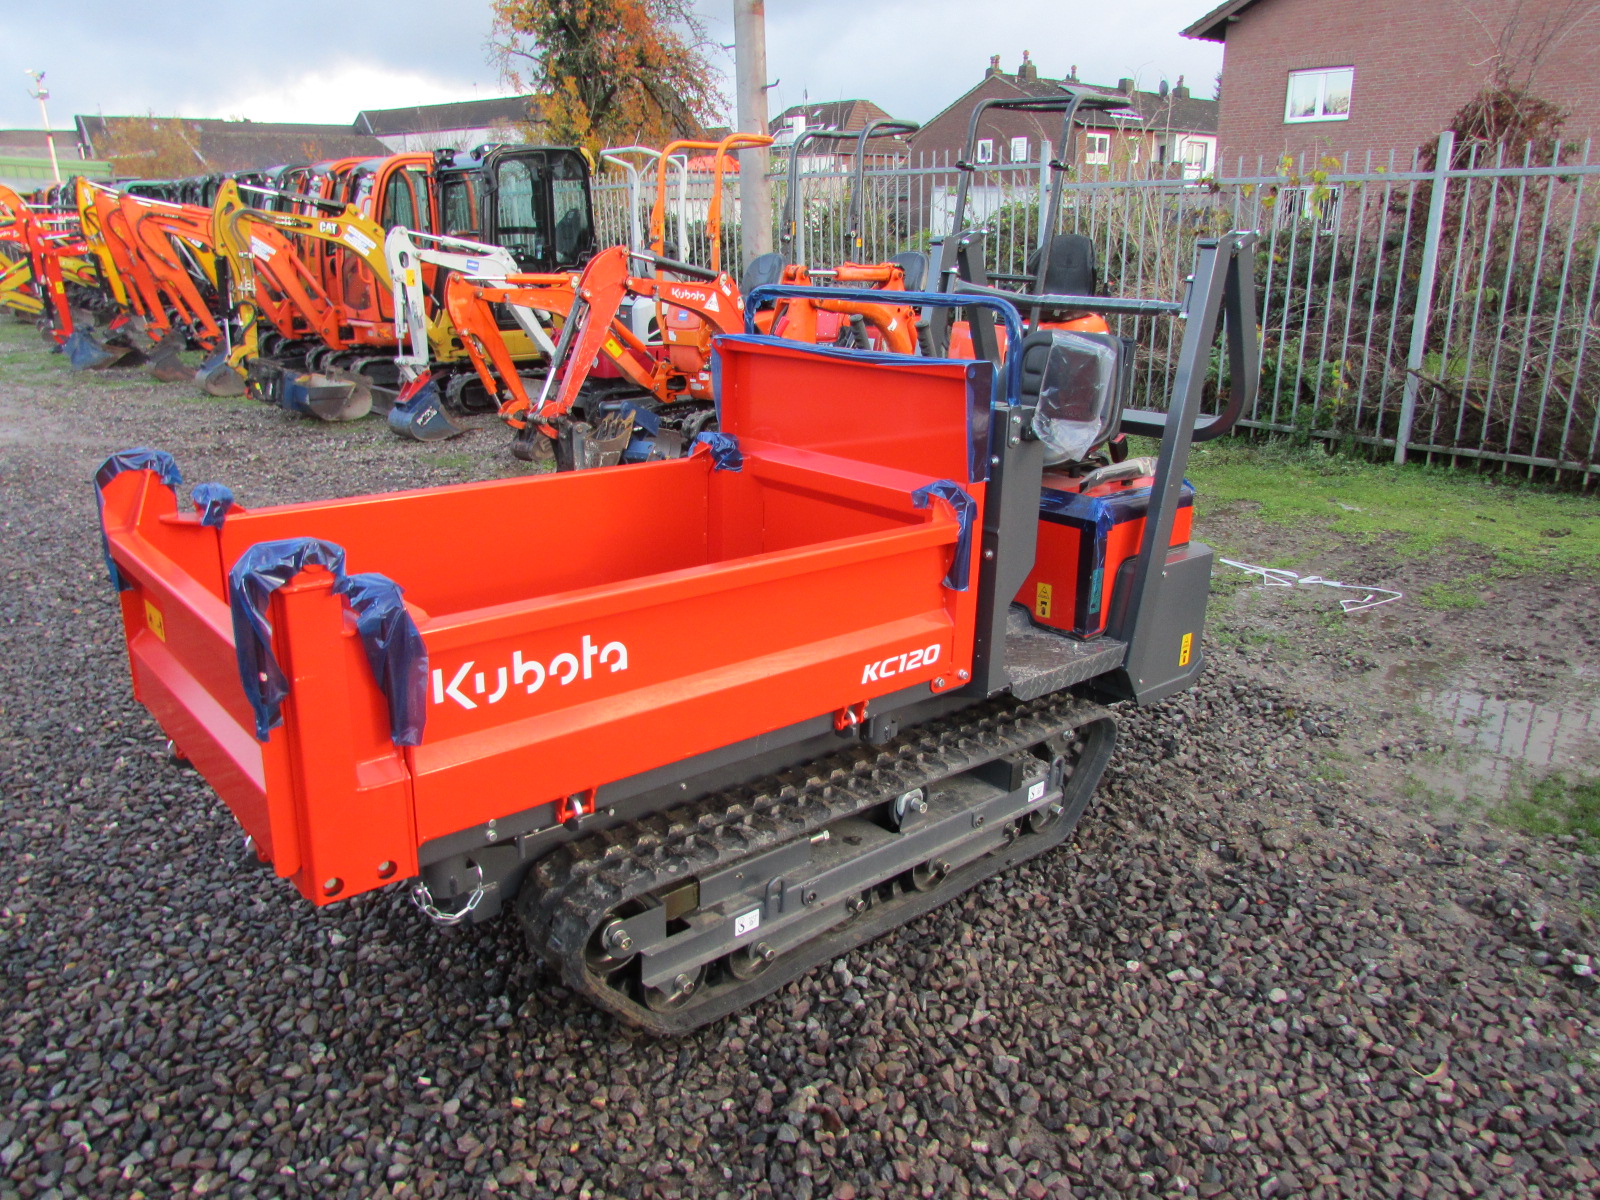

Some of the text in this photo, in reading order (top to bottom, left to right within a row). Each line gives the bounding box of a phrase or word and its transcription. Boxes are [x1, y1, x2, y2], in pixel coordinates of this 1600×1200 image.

[319, 221, 338, 235] CAT
[671, 287, 706, 302] Kubota
[432, 634, 628, 710] Kubota
[861, 643, 941, 685] KC120
